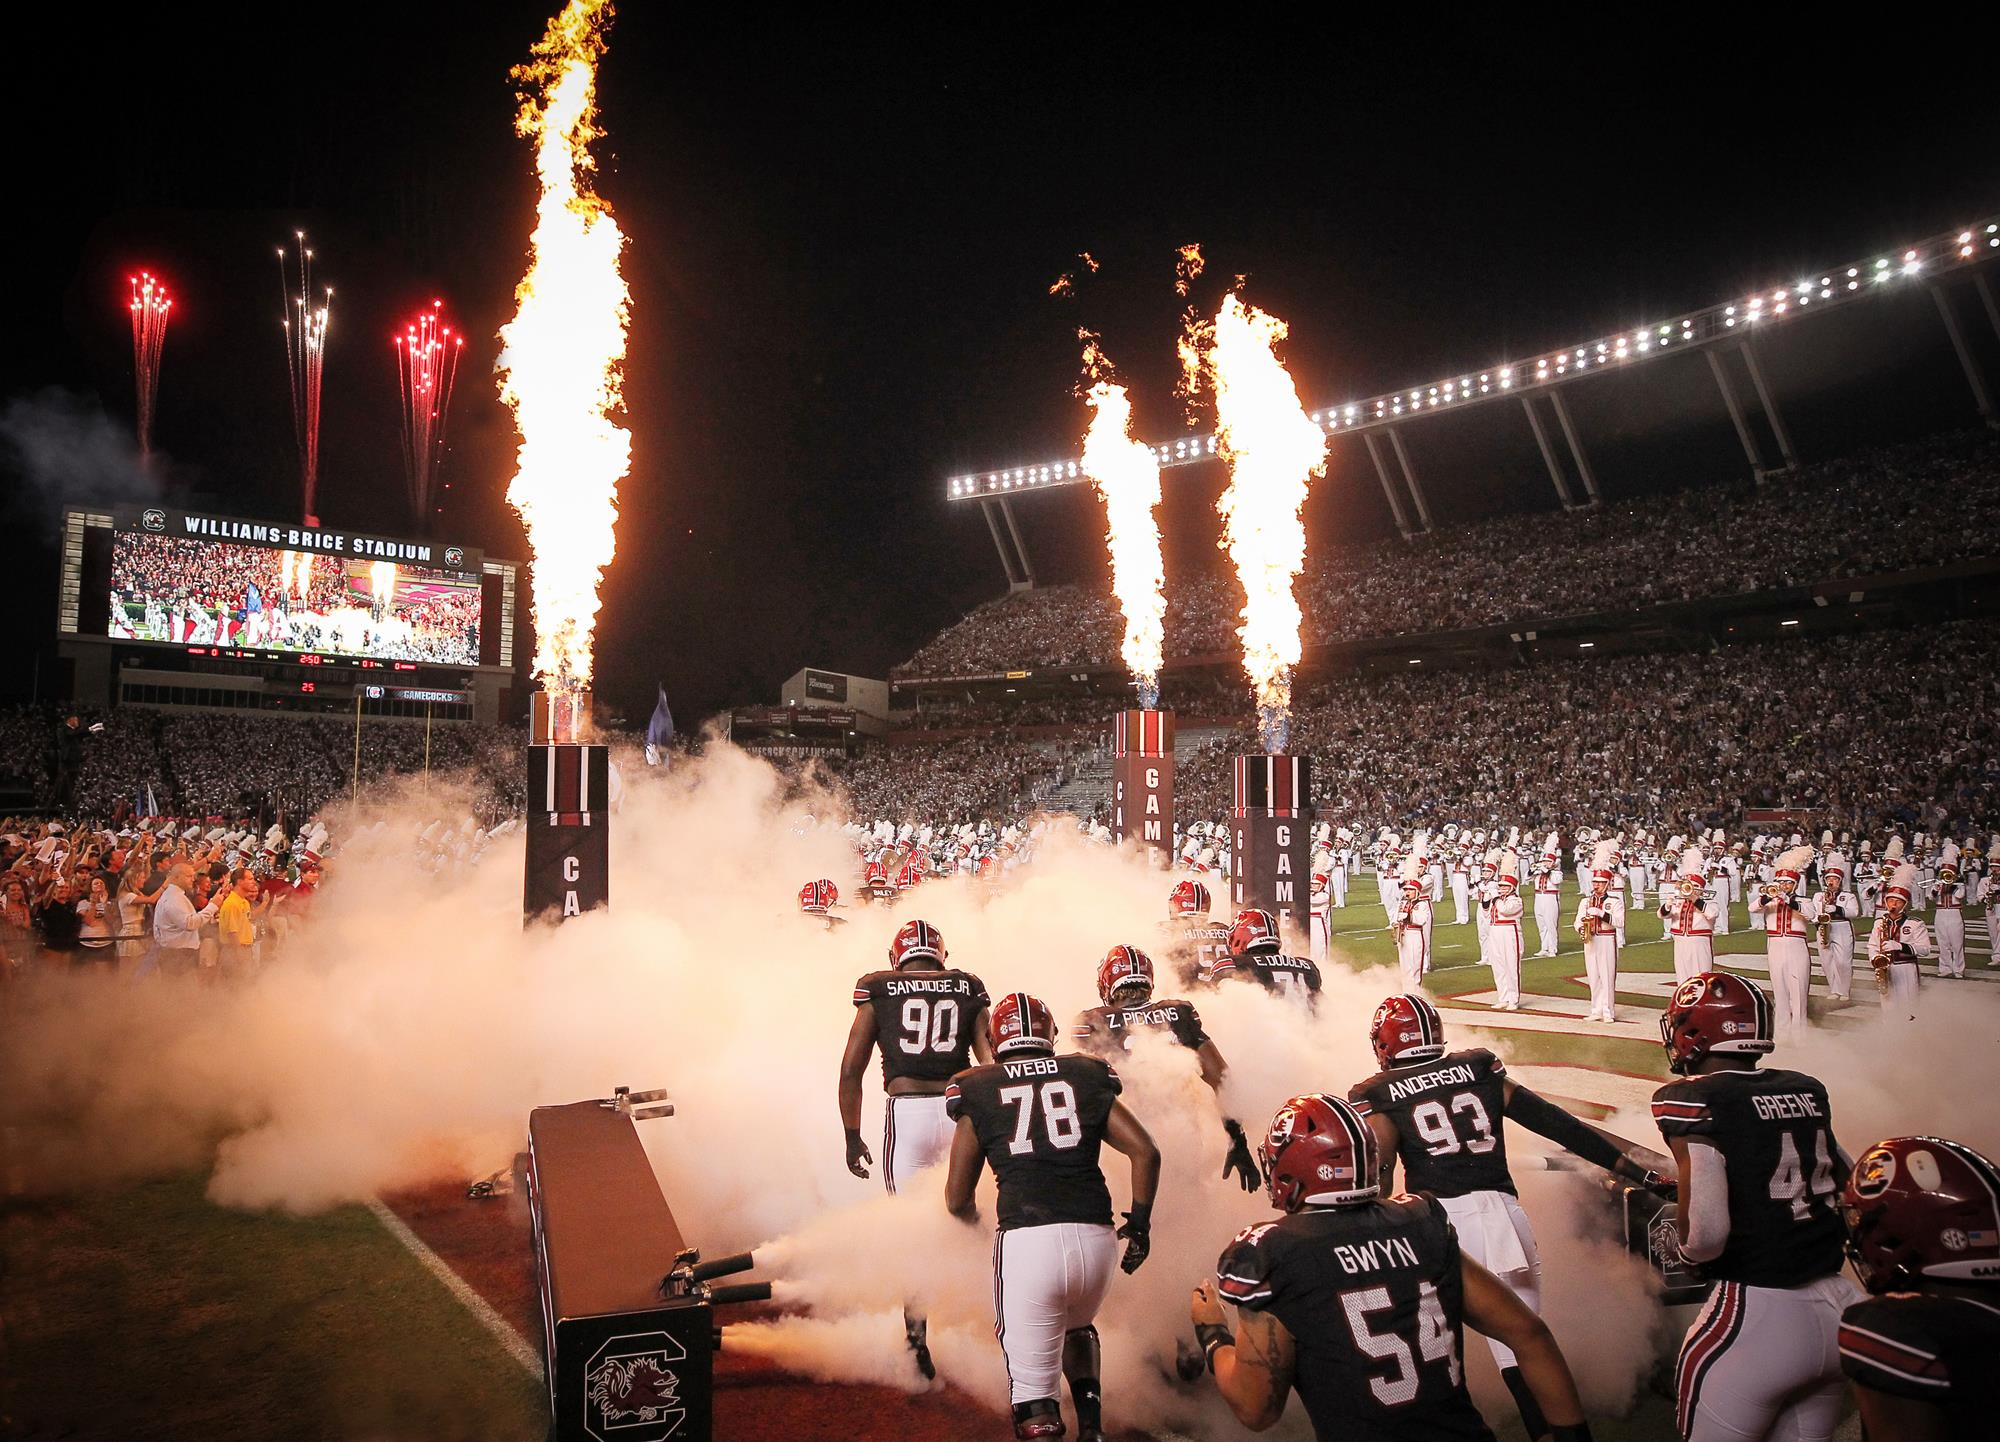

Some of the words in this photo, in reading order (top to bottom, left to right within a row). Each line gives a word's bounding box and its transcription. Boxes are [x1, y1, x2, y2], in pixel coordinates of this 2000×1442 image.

[184, 516, 344, 551] WILLIAMS-BRICE
[353, 538, 431, 561] STADIUM
[302, 683, 315, 692] 25
[403, 690, 454, 702] GAMECOCKS
[1183, 928, 1230, 940] HUTCHERSO
[886, 979, 953, 997] SANDIDGE
[899, 998, 959, 1055] 90
[1106, 1013, 1121, 1029] Z.
[1122, 1007, 1179, 1027] PICKENS
[1003, 1058, 1059, 1080] WEBB
[1388, 1063, 1476, 1102] ANDERSON
[999, 1080, 1082, 1156] 78
[1751, 1093, 1823, 1121] GREENE
[1412, 1092, 1497, 1157] 93
[1317, 1165, 1334, 1180] SEC
[1768, 1128, 1837, 1221] 44
[1943, 1230, 1966, 1250] SEC
[1333, 1237, 1420, 1275] GWYN
[1339, 1280, 1462, 1406] 54
